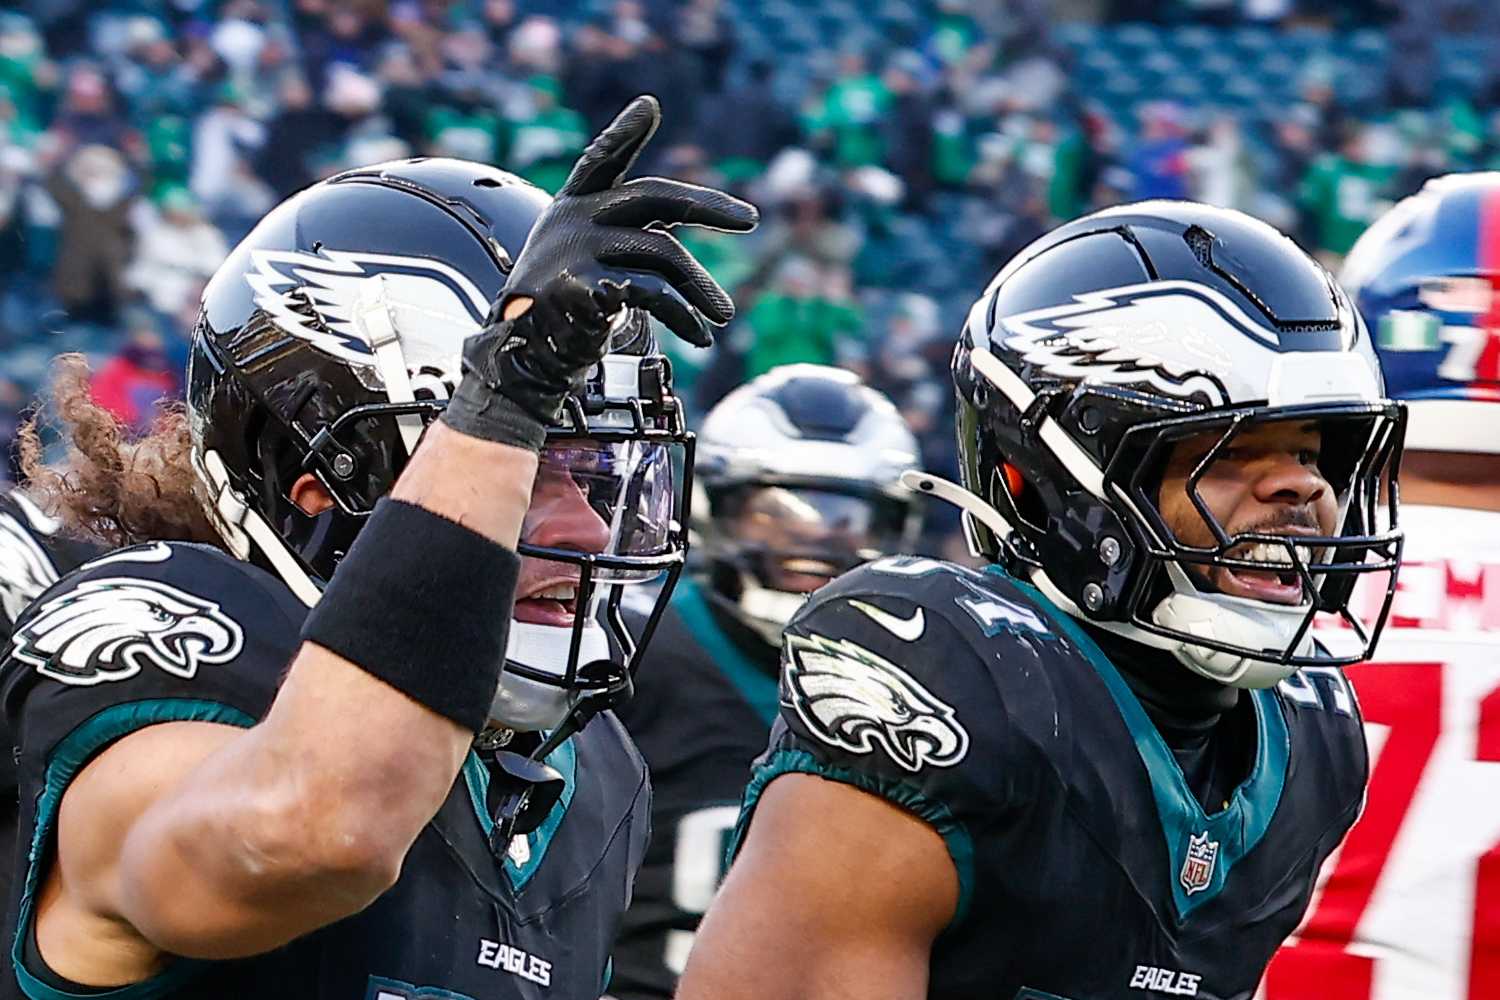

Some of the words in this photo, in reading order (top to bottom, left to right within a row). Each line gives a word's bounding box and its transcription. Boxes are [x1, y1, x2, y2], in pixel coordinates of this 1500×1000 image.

[1183, 860, 1208, 884] NFL
[477, 938, 553, 988] EAGLES
[1129, 964, 1203, 997] EAGLES
